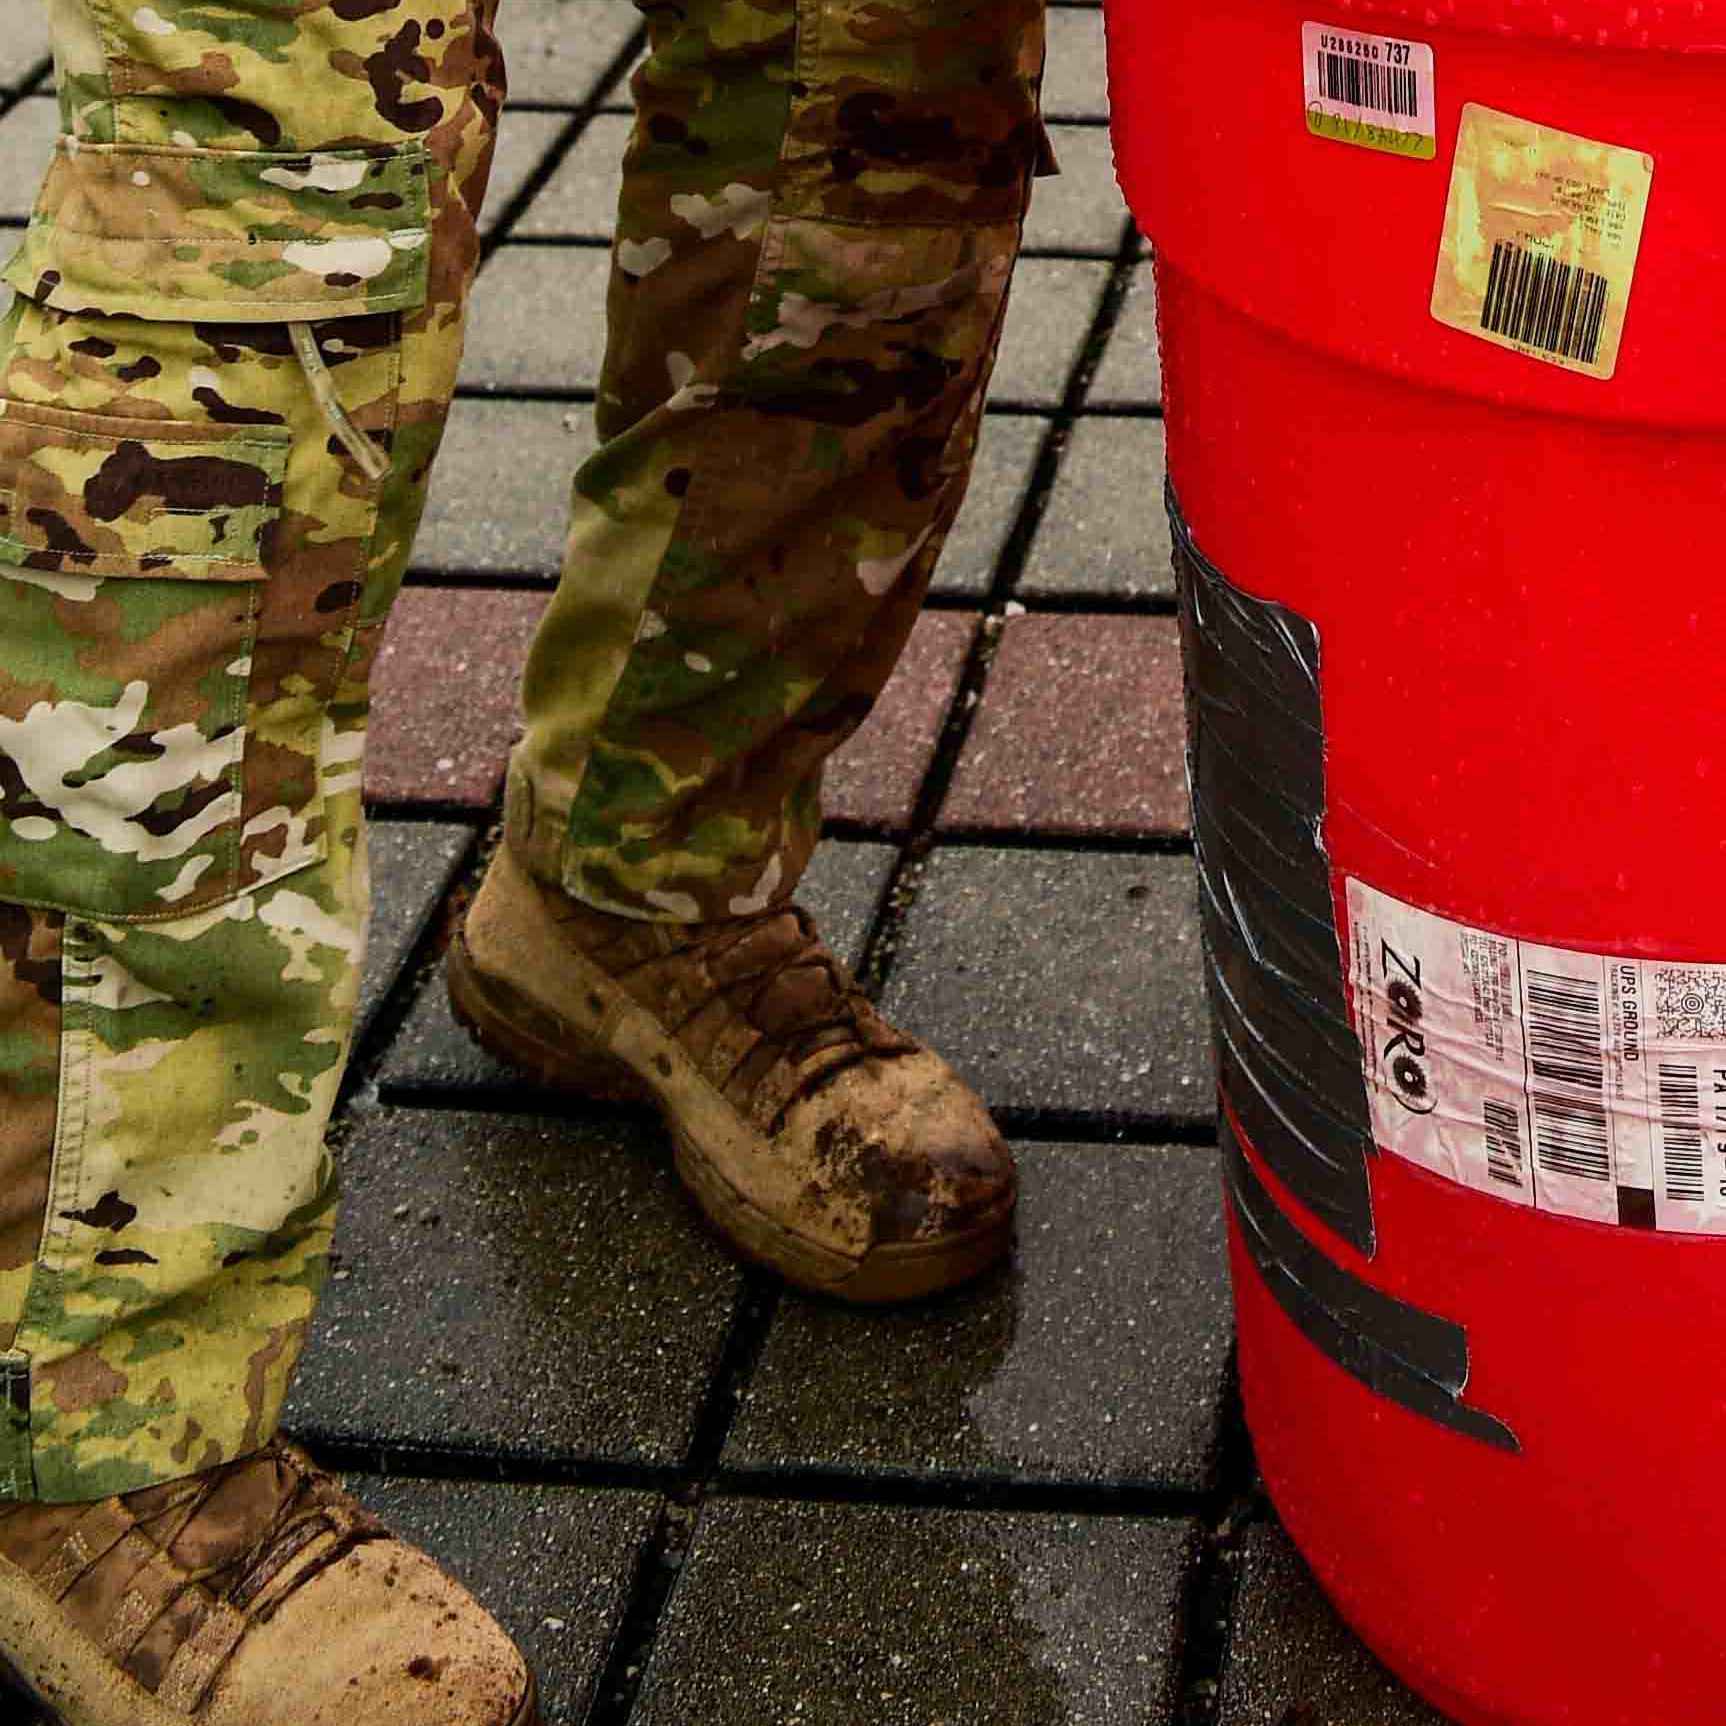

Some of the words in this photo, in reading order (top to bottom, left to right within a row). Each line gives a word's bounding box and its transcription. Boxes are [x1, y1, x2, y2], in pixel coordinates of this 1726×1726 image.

[1384, 42, 1410, 65] 737
[1620, 966, 1636, 995] UPS
[1623, 1001, 1639, 1061] GROUND
